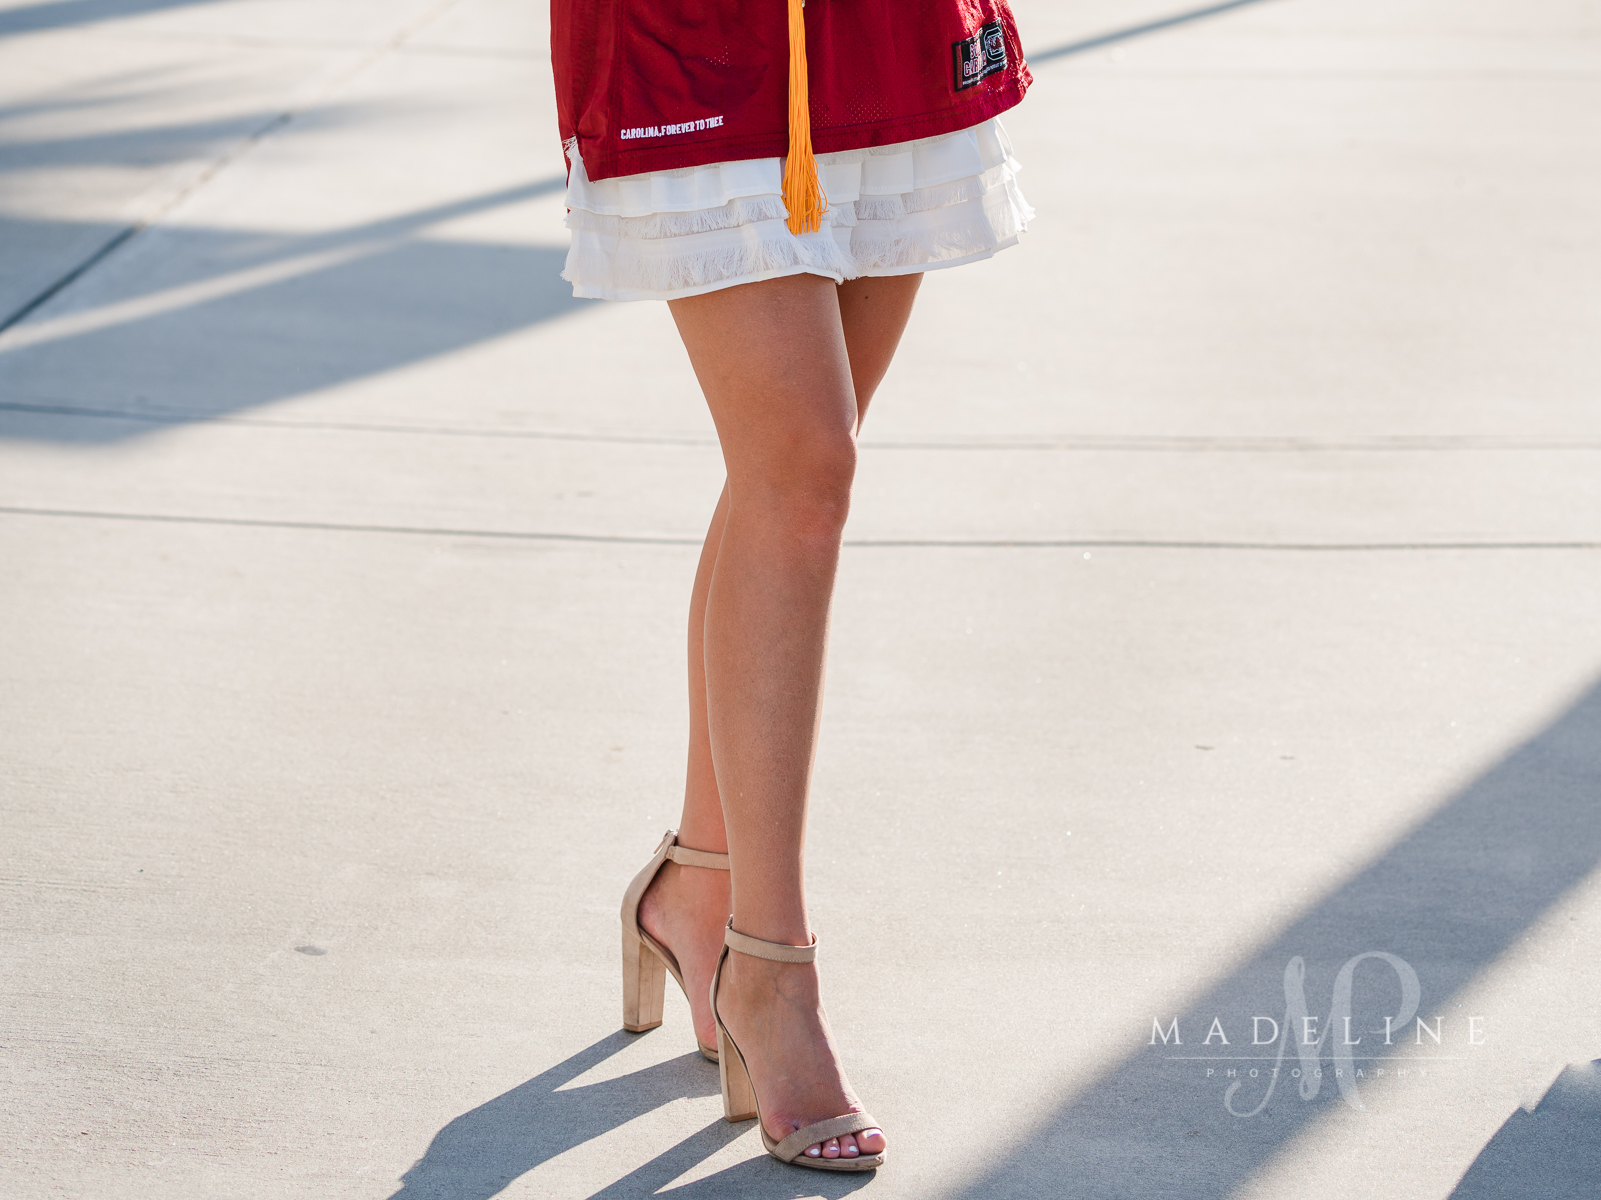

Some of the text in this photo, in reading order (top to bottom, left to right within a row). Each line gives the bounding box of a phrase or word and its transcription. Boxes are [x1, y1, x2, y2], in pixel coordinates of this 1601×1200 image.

[661, 121, 695, 136] FOREVER
[695, 119, 705, 131] TO
[705, 115, 724, 129] THEE
